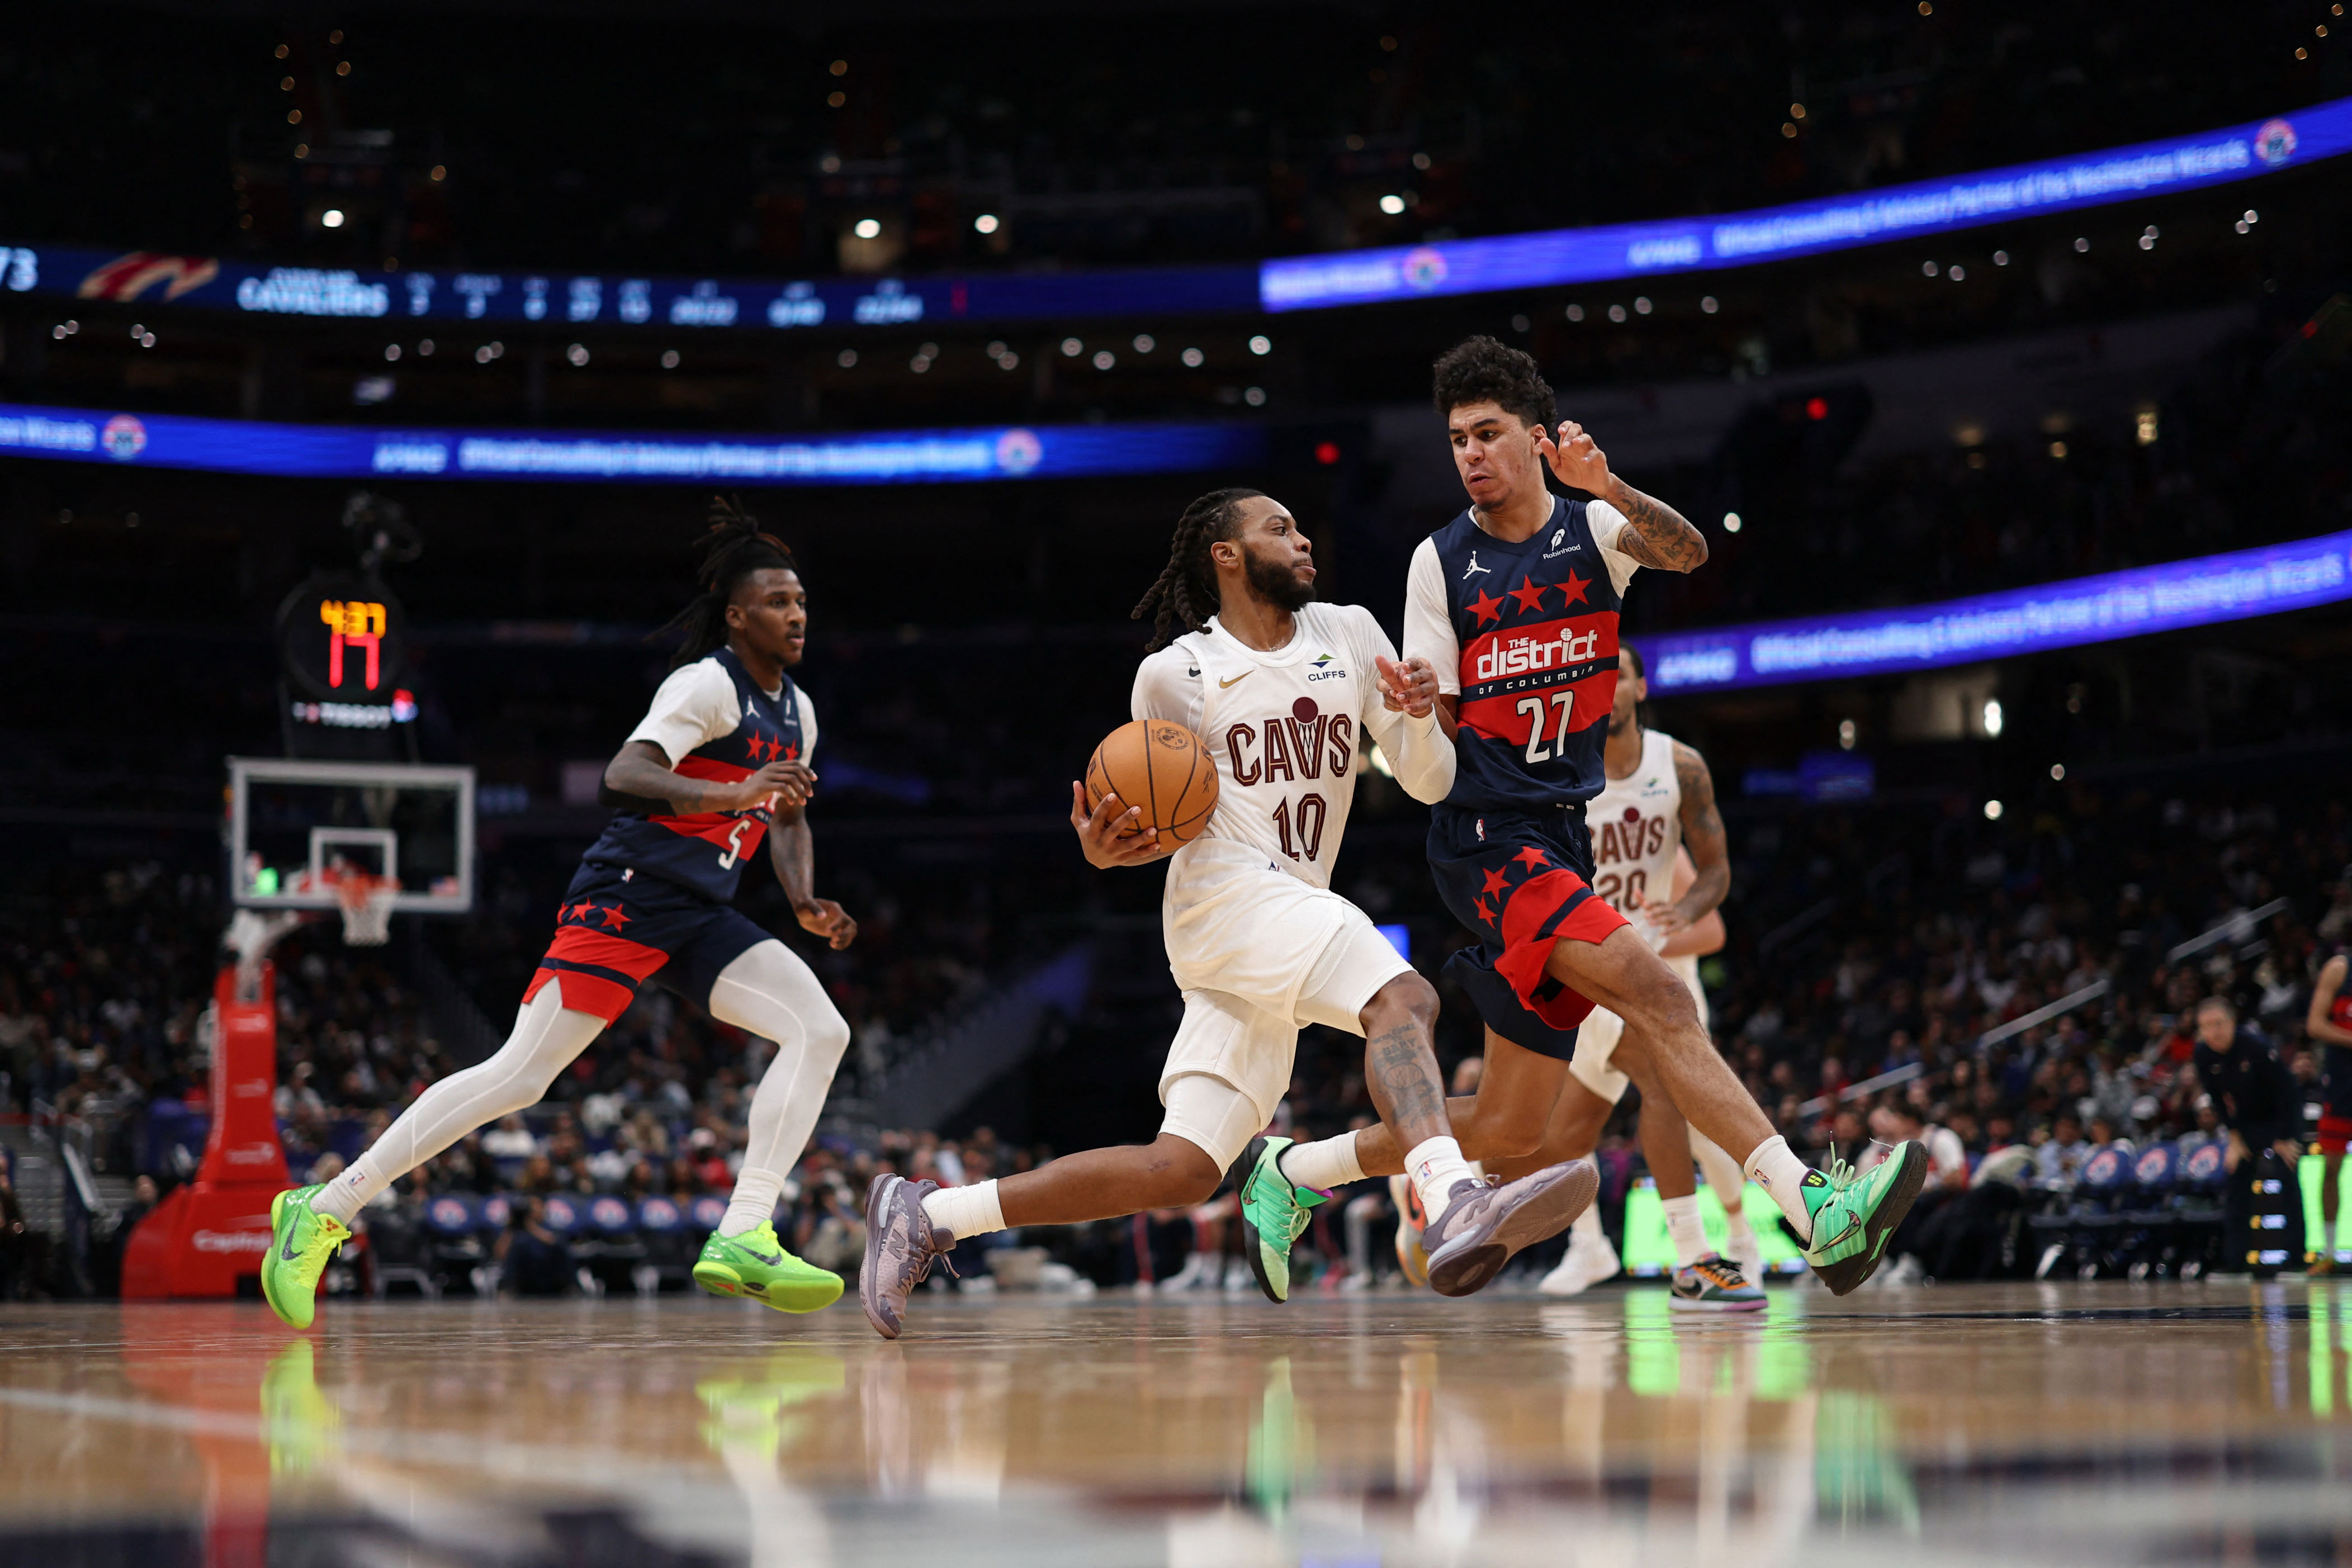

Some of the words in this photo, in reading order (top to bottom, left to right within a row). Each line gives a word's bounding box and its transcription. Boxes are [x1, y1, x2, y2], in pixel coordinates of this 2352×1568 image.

[1543, 543, 1581, 560] Robinhood
[1477, 628, 1598, 680] district
[1508, 637, 1529, 649] THE
[1308, 670, 1346, 681] CLIFFS
[1479, 685, 1493, 694] OF
[1506, 665, 1594, 690] COLUMBIA
[1226, 713, 1352, 787] CAVS
[1516, 690, 1574, 764] 27
[718, 819, 752, 870] 5
[1272, 793, 1326, 863] 10
[1597, 869, 1646, 913] 20
